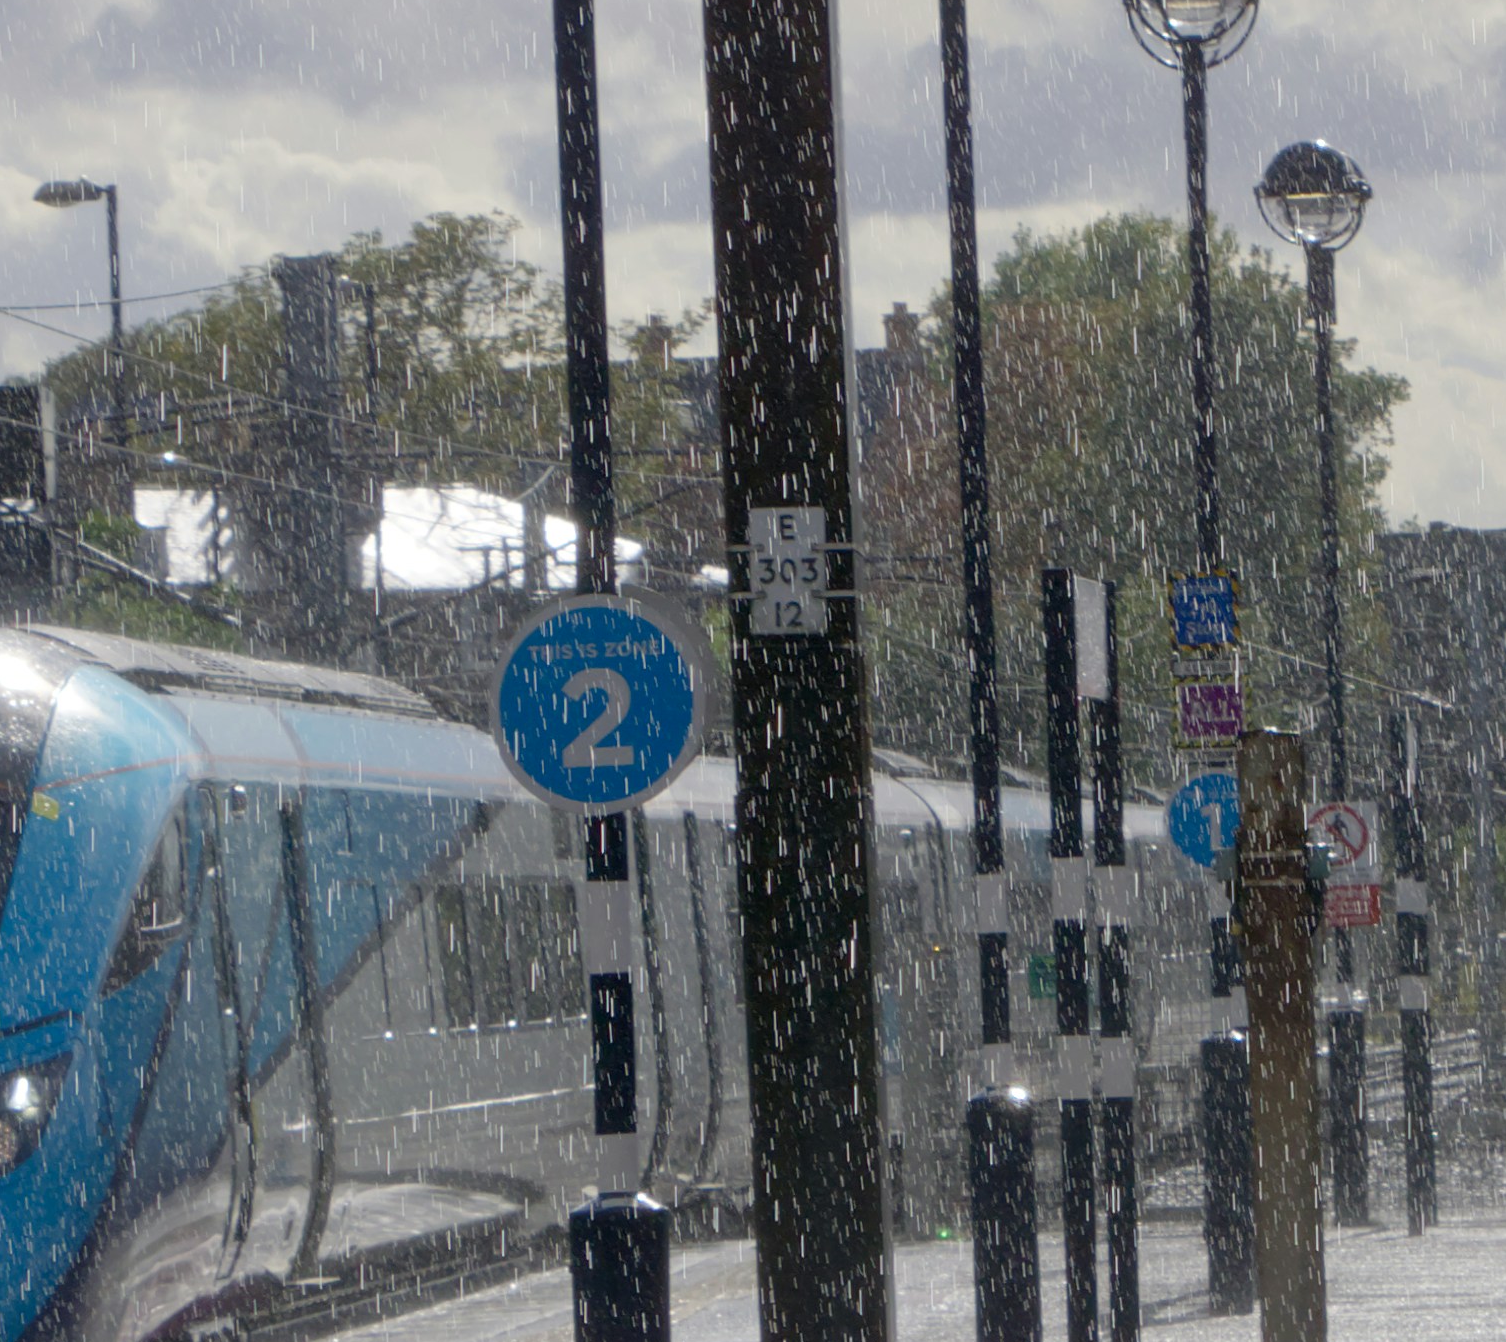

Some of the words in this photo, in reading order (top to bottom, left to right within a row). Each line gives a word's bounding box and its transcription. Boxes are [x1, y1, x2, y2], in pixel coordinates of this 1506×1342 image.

[779, 514, 795, 539] E
[758, 558, 818, 584] 303
[775, 601, 802, 627] 12
[528, 644, 573, 660] THIS
[579, 643, 598, 659] IS
[605, 640, 661, 658] ZONE
[561, 668, 634, 768] 2
[1200, 802, 1222, 851] 1
